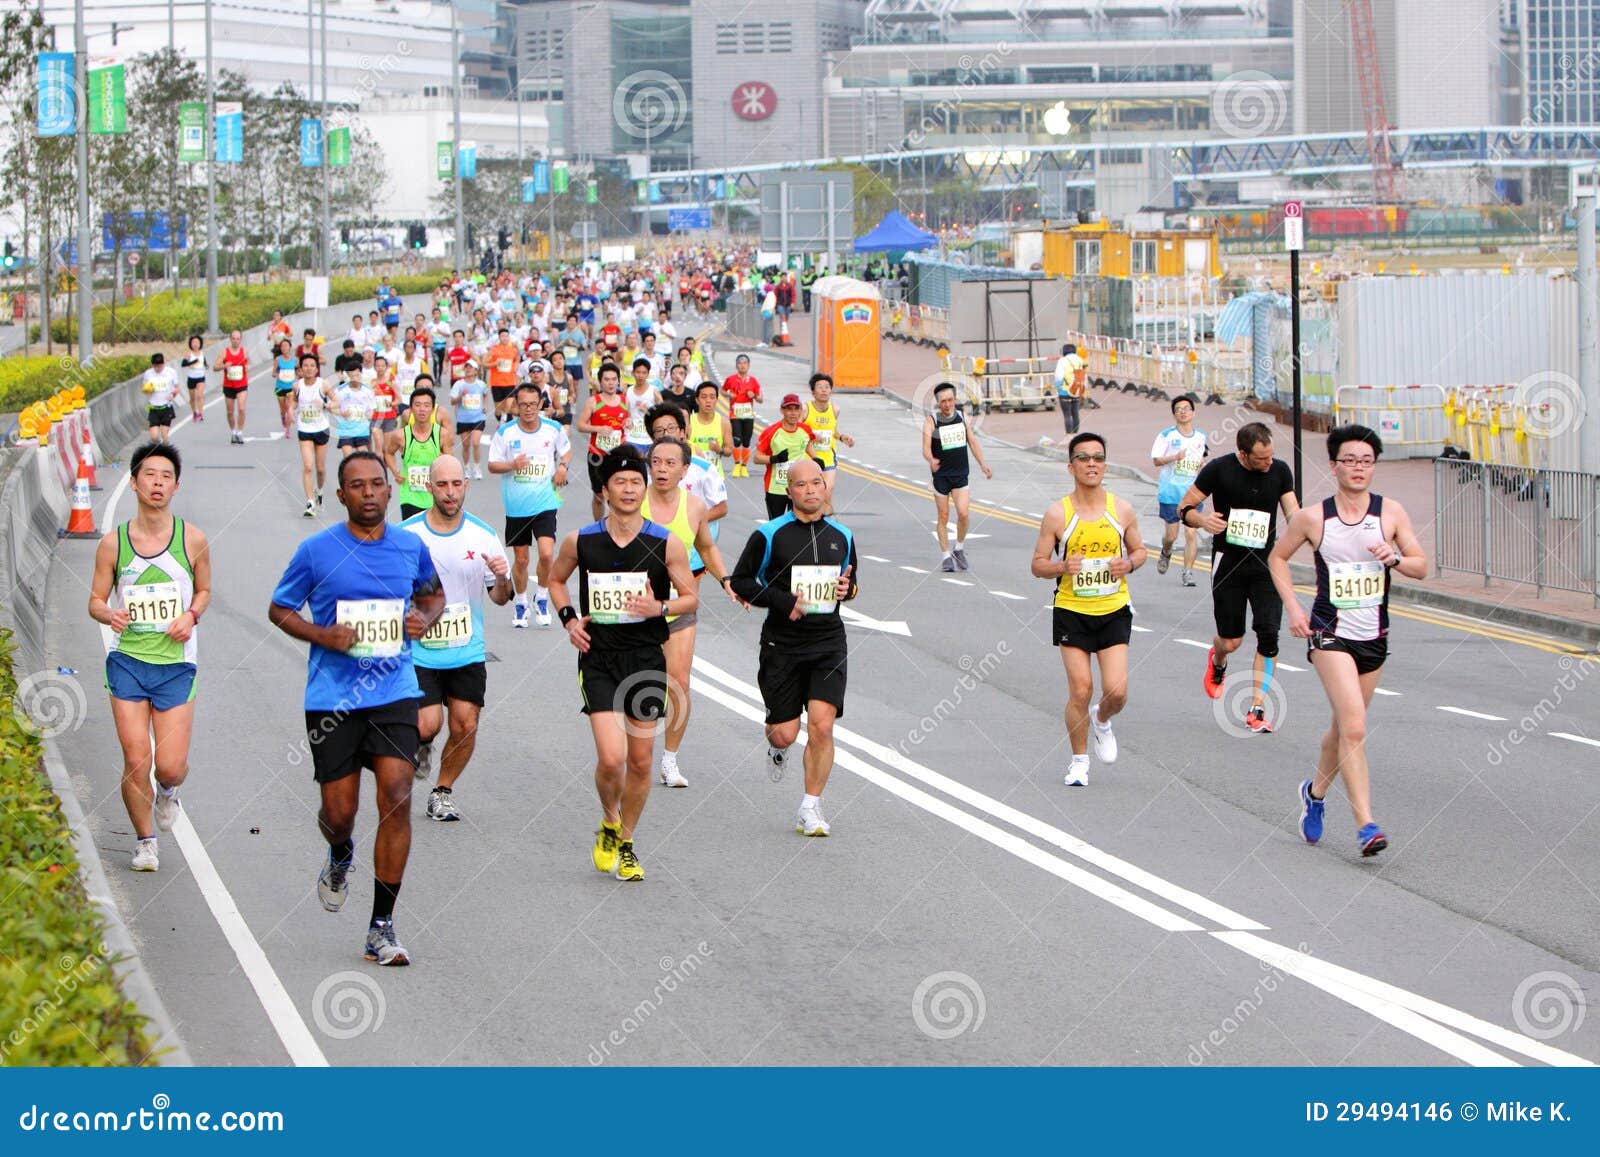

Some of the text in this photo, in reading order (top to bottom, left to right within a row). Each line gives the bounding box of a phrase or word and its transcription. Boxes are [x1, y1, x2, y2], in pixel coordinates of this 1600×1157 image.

[1230, 520, 1266, 539] 55158
[1334, 576, 1381, 598] 54101
[128, 599, 177, 622] 61167
